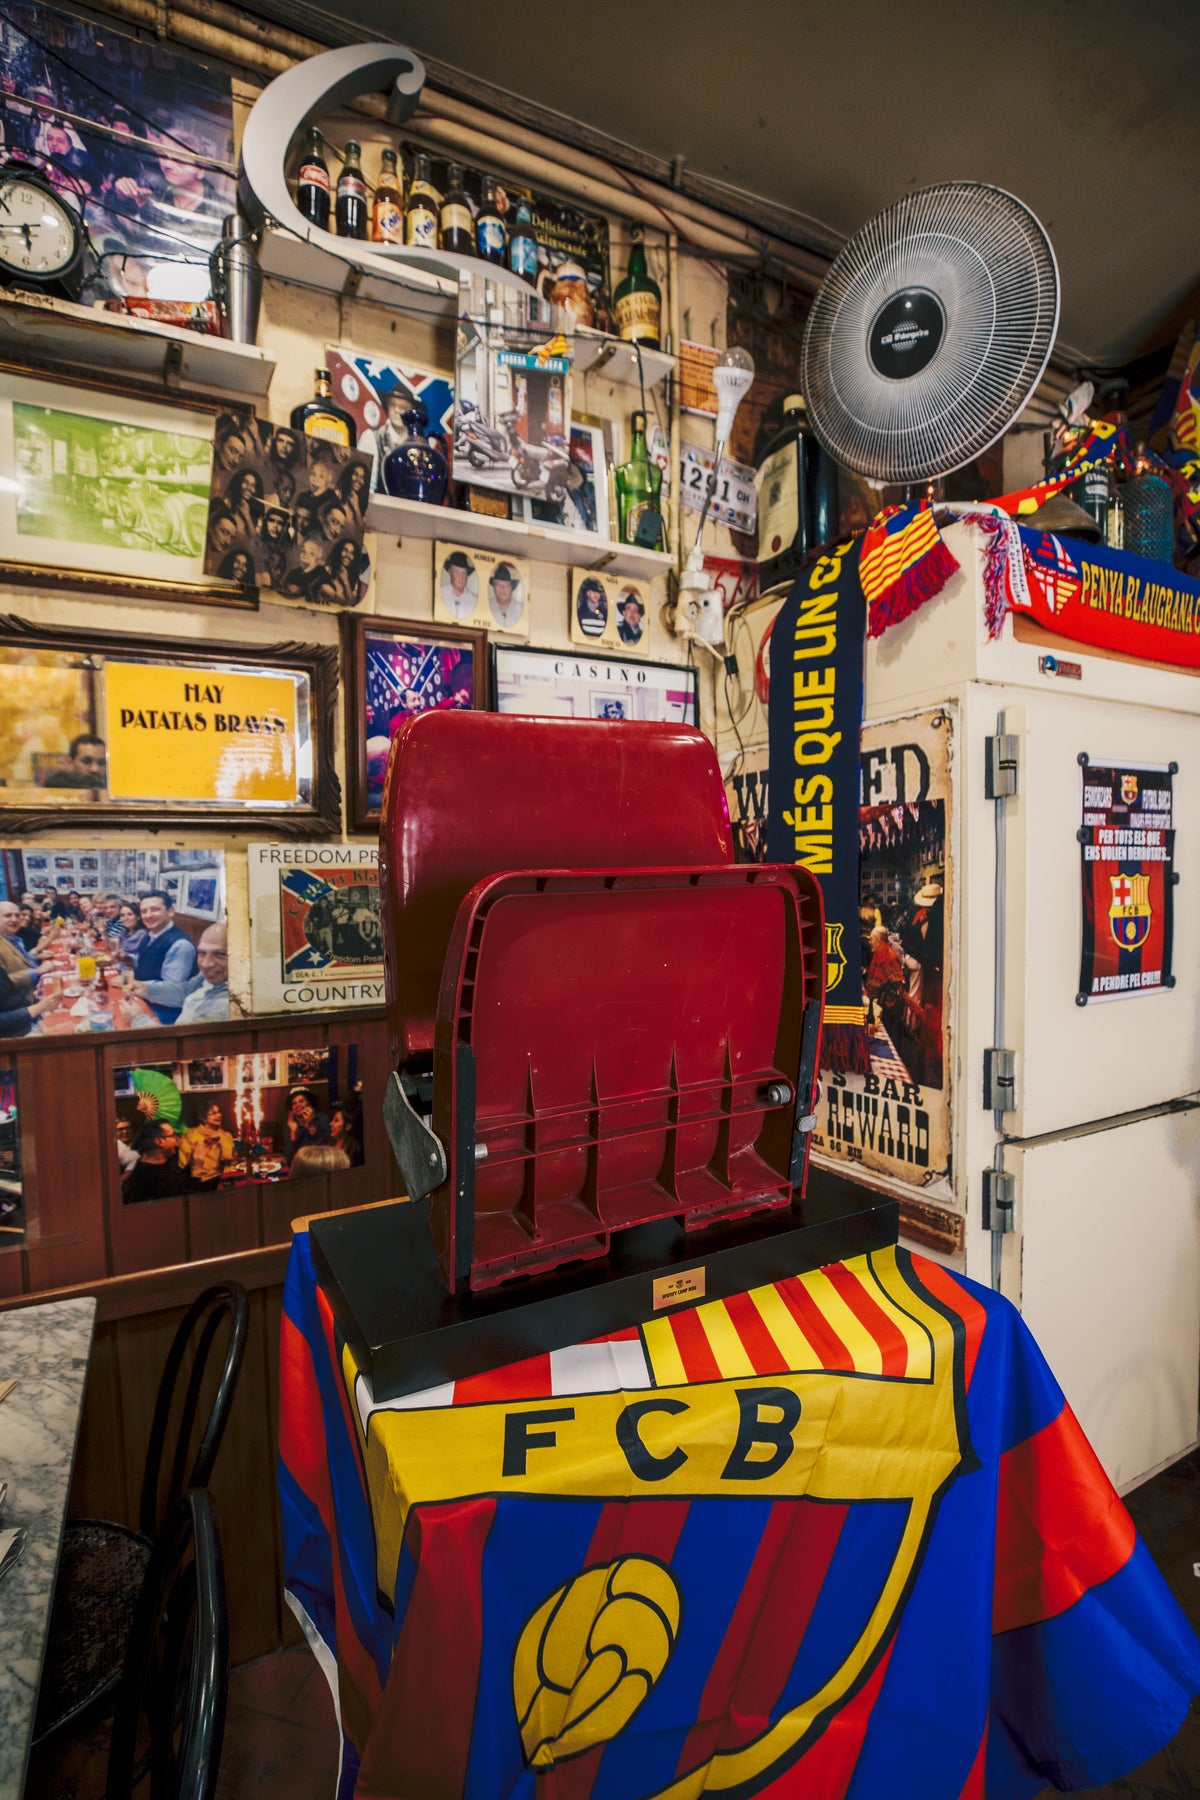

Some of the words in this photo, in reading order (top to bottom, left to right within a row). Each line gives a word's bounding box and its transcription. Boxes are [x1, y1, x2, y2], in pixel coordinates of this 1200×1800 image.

[20, 192, 33, 205] 12
[1080, 561, 1124, 621] PENYA
[1124, 576, 1194, 635] BLAUGRANA
[793, 592, 839, 661] UN
[554, 661, 646, 683] CASINO
[184, 683, 225, 704] HAY
[120, 709, 208, 732] PATATAS
[214, 713, 286, 734] BRAVAS
[793, 667, 842, 766] QUE
[783, 774, 834, 873] MÉS
[1098, 829, 1114, 845] PER
[1114, 829, 1133, 845] TOTS
[1133, 830, 1146, 845] ELS
[1146, 830, 1161, 846] QUE
[259, 849, 352, 864] FREEDOM
[1084, 844, 1100, 861] ENS
[288, 874, 347, 916] Country
[1122, 906, 1139, 916] FCB
[283, 983, 385, 1004] COUNTRY
[1092, 977, 1099, 993] A
[1100, 973, 1129, 992] PENDRE
[1129, 972, 1142, 988] PEL
[863, 1073, 924, 1107] BAR
[827, 1086, 929, 1168] REWARD
